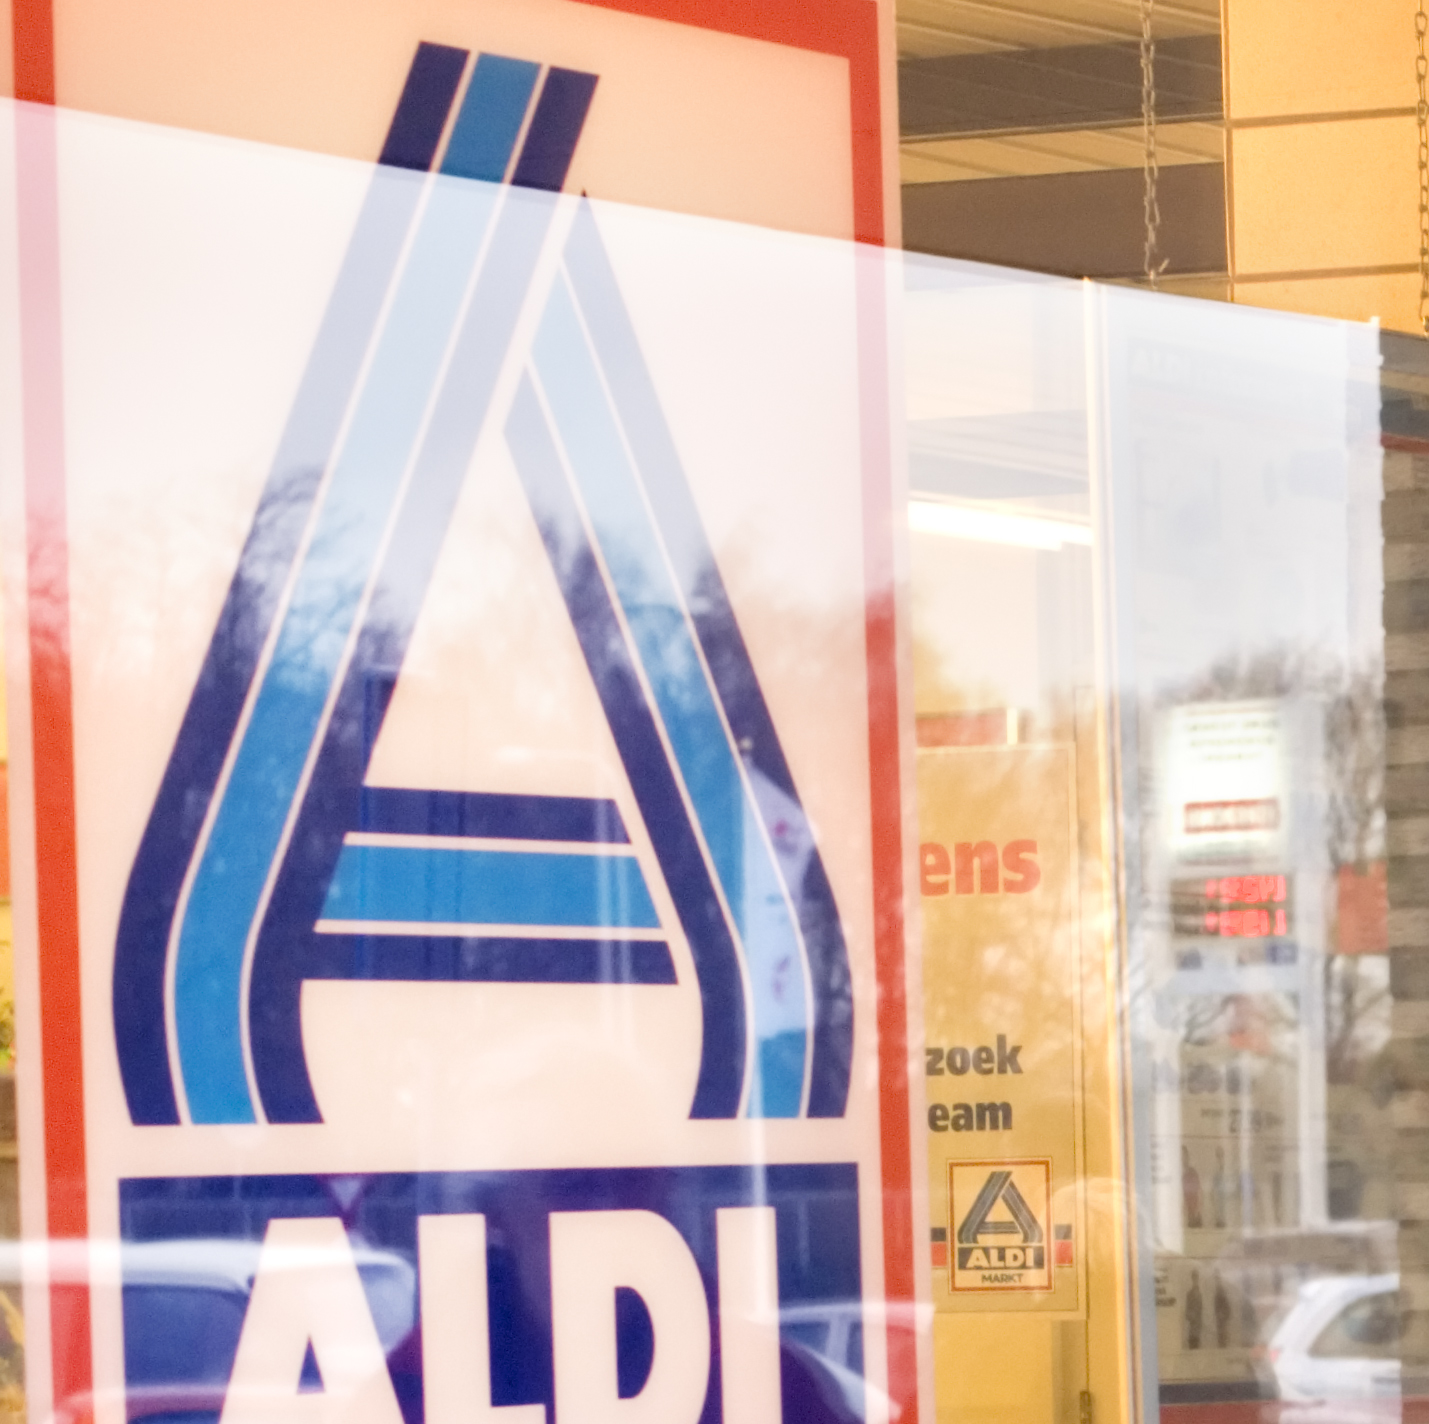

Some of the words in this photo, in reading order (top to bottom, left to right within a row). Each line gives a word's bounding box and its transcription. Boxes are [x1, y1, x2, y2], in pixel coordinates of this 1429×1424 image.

[919, 838, 1042, 897] ens
[925, 1033, 1023, 1077] zoek
[928, 1100, 1013, 1133] eam
[965, 1246, 1035, 1270] ALDI
[981, 1272, 1024, 1284] MARKT
